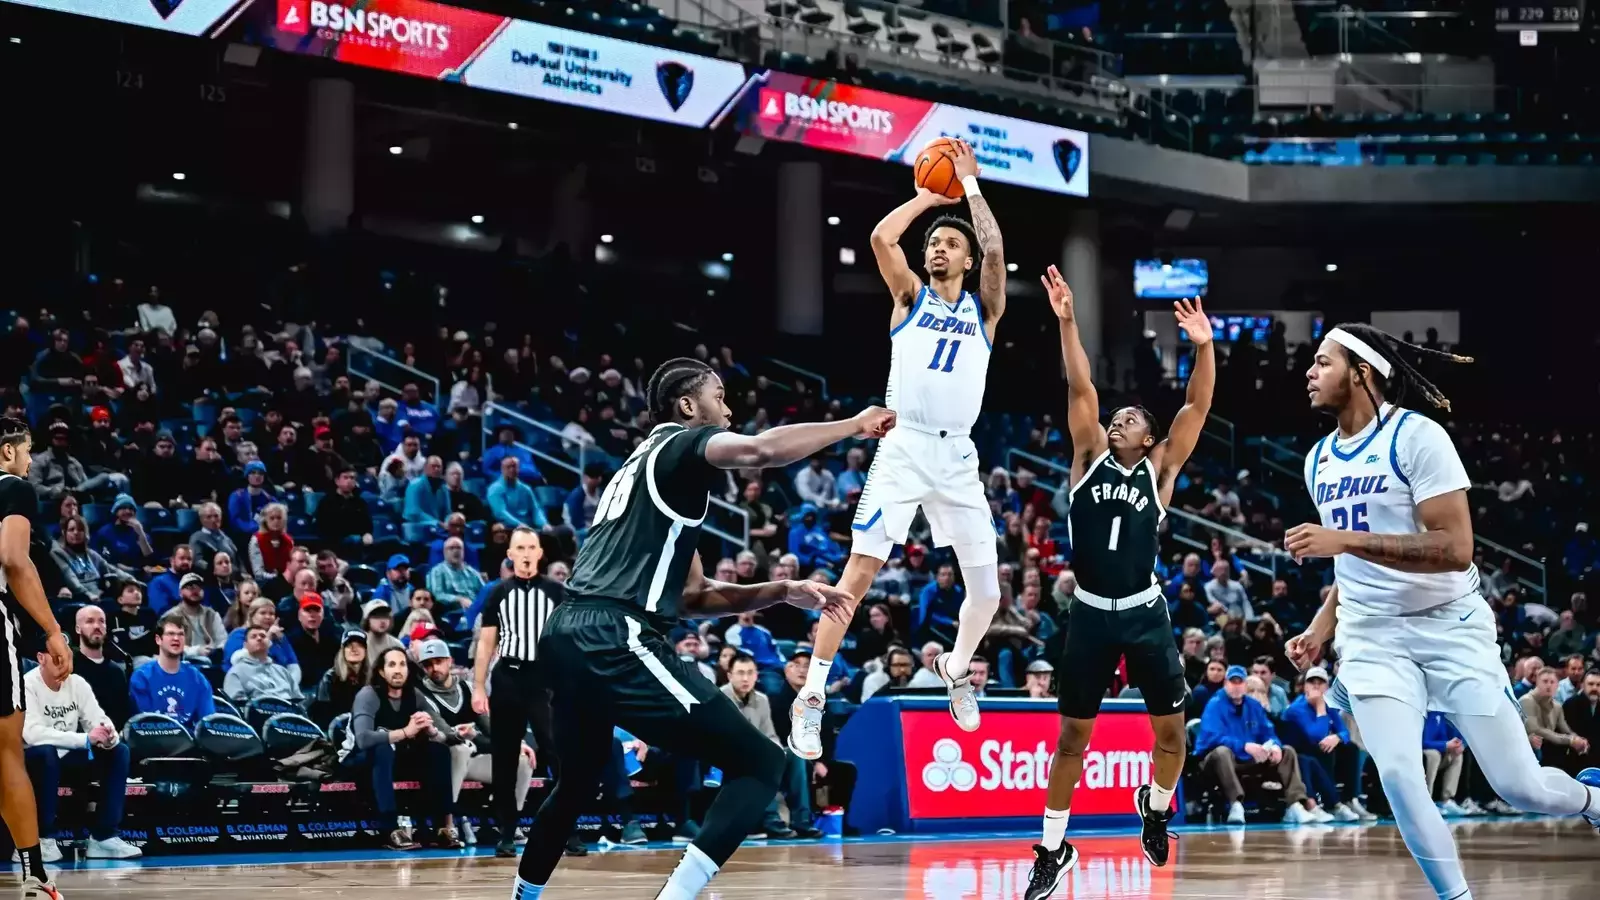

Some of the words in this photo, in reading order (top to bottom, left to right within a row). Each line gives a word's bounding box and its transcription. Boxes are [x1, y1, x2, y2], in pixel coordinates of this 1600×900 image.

[1552, 6, 1579, 21] 230
[512, 49, 560, 71] DePaul
[565, 60, 632, 87] University
[200, 84, 226, 102] 125
[543, 72, 602, 95] Athletics
[927, 338, 961, 373] 11
[1091, 483, 1149, 512] FRIARS
[1108, 516, 1122, 551] 1
[216, 730, 245, 739] AVIATION
[980, 739, 1054, 790] Stat
[1074, 741, 1150, 789] arm
[172, 835, 210, 844] AVIATION
[242, 833, 279, 841] AVIATION
[312, 830, 348, 839] AVIATION
